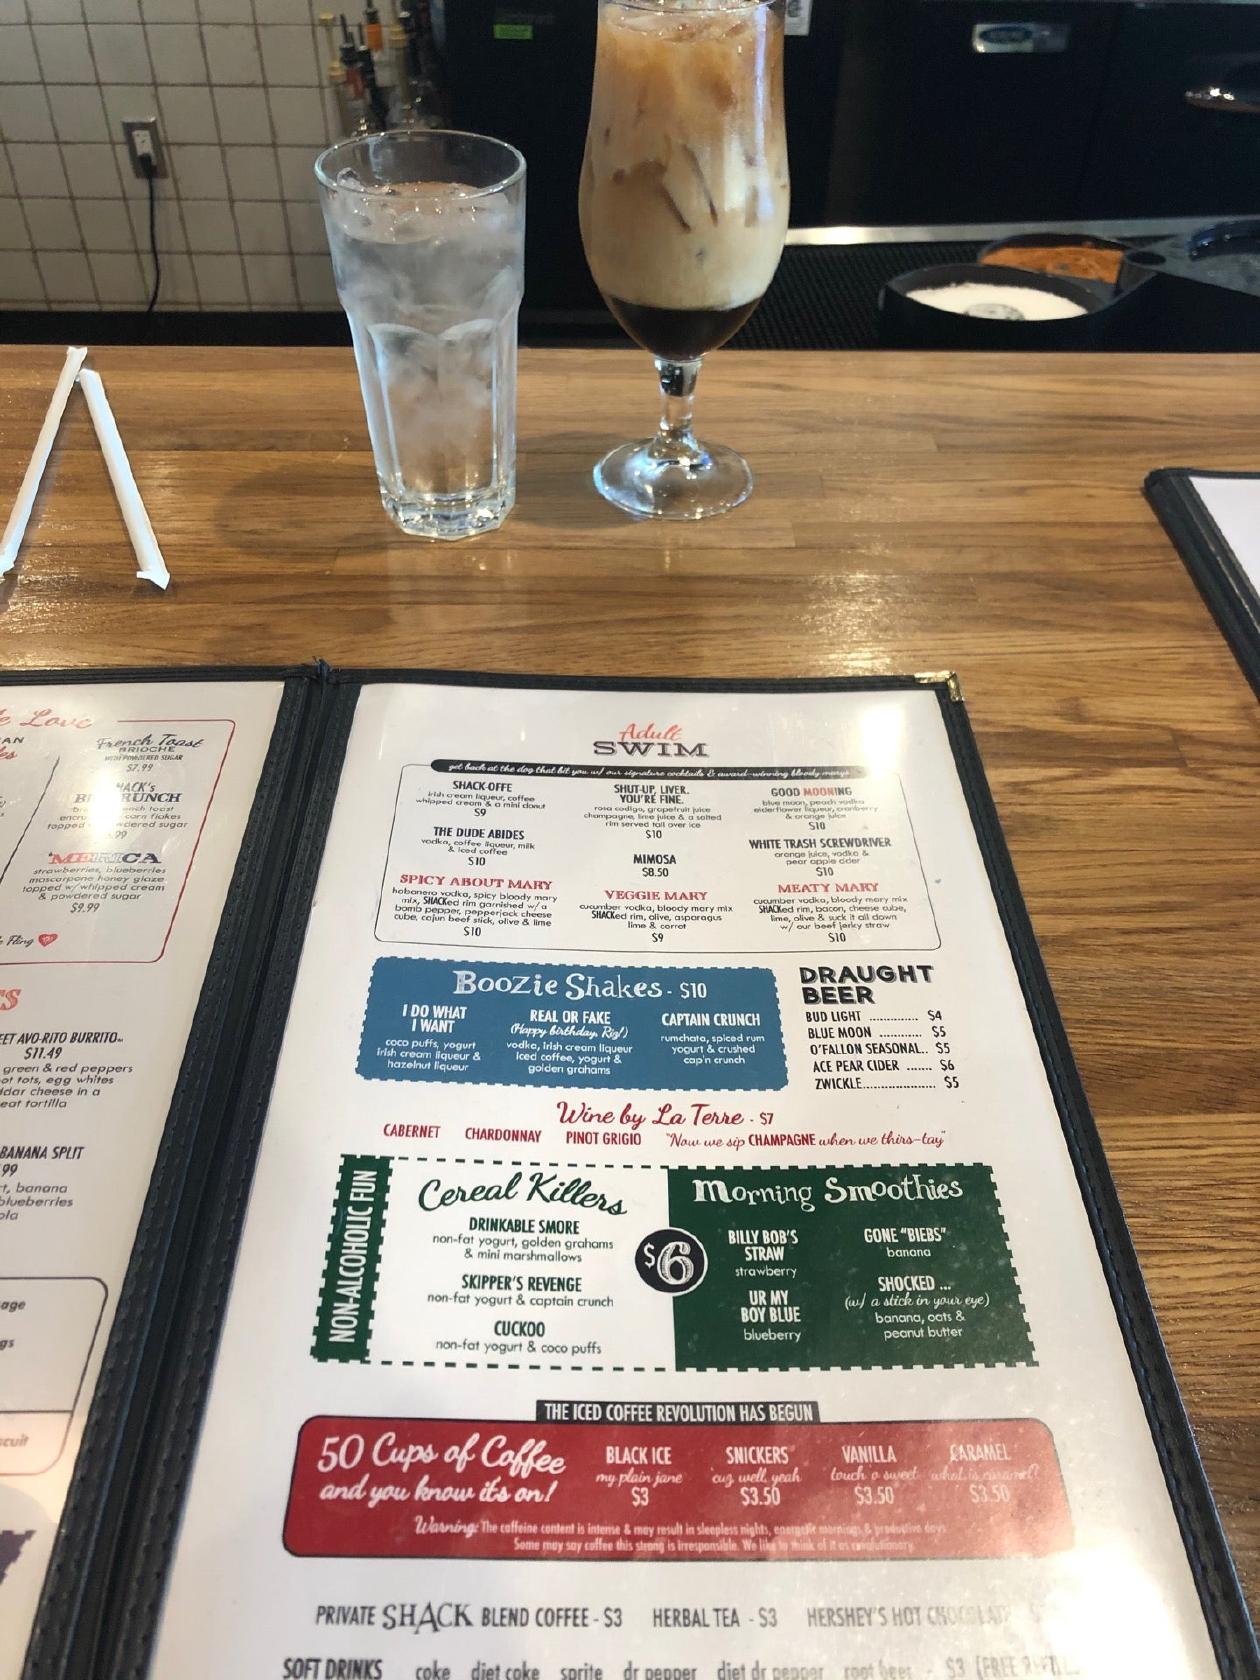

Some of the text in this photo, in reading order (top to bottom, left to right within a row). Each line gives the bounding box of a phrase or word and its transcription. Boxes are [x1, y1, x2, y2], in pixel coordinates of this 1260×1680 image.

[619, 723, 682, 741] Adult
[593, 741, 709, 757] SWIM
[126, 764, 154, 772] $7.99
[452, 780, 513, 792] SHACK-OFFE
[614, 784, 690, 796] SHUT-UP, LIVER.
[771, 787, 852, 796] GOOD MOONING
[620, 795, 684, 804] YOU'RE FINE.
[474, 806, 487, 816] $9
[434, 826, 524, 839] THE DUDE ABIDES
[808, 821, 825, 830] $10
[645, 829, 661, 839] $10
[748, 837, 891, 849] WHITE TRASH SCREWDRIVER
[468, 856, 485, 865] $10
[633, 854, 676, 864] MIMOSA
[642, 867, 668, 877] $8.50
[400, 874, 552, 890] SPICY ABOUT MARY
[778, 882, 878, 893] MEATY MARY
[604, 890, 707, 900] VEGGIE MARY
[70, 902, 100, 913] $9.99
[463, 926, 481, 936] $10
[651, 932, 663, 942] $9
[6, 934, 33, 947] Fling
[800, 965, 934, 984] DRAUGHT
[452, 970, 706, 1000] Boozie Shakes $10
[802, 986, 875, 1004] BEER
[402, 1004, 467, 1019] I DO WHAT
[530, 1009, 610, 1026] REAL OR FAKE
[805, 1011, 860, 1022] BUD LIGHT
[927, 1009, 941, 1021] $4
[412, 1018, 455, 1033] I WANT
[661, 1013, 760, 1026] CAPTAIN CRUNCH
[17, 1032, 67, 1044] AVO-RITO
[808, 1026, 871, 1038] BLUE MOON
[931, 1025, 945, 1037] $5
[24, 1046, 62, 1059] $11.49
[810, 1043, 862, 1055] O'FALLON
[935, 1041, 950, 1054] $5
[683, 1053, 745, 1065] cap'n crunch
[813, 1059, 899, 1072] ACE PEAR CIDER
[939, 1059, 954, 1071] $6
[3, 1063, 132, 1076] green & red peppers
[17, 1075, 114, 1087] tots, egg whites
[25, 1098, 66, 1108] tortilla
[556, 1101, 773, 1130] Wine by La Terre $7
[383, 1123, 440, 1138] CABERNET
[465, 1127, 541, 1142] CHARDONNAY
[566, 1130, 641, 1145] PINOT GRIGIO
[749, 1133, 816, 1146] CHAMPAGNE
[51, 1146, 84, 1160] SPLIT
[15, 1182, 67, 1193] banana
[418, 1172, 628, 1215] Cereal Killers
[692, 1174, 962, 1211] Morning Smoothies
[469, 1217, 579, 1234] DRINKABLE SMORE
[728, 1229, 798, 1244] BILLY BOB'S
[864, 1227, 945, 1242] GONE "BIEBS"
[432, 1233, 613, 1251] non-fat yogurt, golden grahams
[329, 1170, 377, 1343] NON-ALCOHOLIC FUN
[744, 1245, 784, 1263] STRAW
[886, 1246, 930, 1257] banana
[643, 1241, 694, 1285] $6
[735, 1264, 796, 1278] strawberry
[461, 1274, 581, 1292] SKIPPER'S REVENGE
[878, 1275, 934, 1293] SHOCKED
[749, 1289, 787, 1307] UR MY
[740, 1306, 800, 1324] BOY BLUE
[494, 1320, 545, 1337] CUCKOO
[743, 1328, 801, 1342] blueberry
[884, 1326, 962, 1341] peanut butter
[544, 1403, 812, 1421] THE ICED COFFEE REVOLUTION HAS BEGUN
[317, 1431, 567, 1478] 50 Cups of Coffee
[606, 1446, 671, 1464] BLACK ICE
[725, 1446, 788, 1464] SNICKERS
[841, 1445, 897, 1463] VANILLA
[319, 1473, 558, 1508] and you know on!
[631, 1486, 648, 1506] $3
[740, 1485, 780, 1506] $3.50
[852, 1484, 896, 1506] $3.50
[315, 1601, 621, 1635] PRIVATE SHACK BLEND COFFEE $3
[653, 1607, 777, 1627] HERBAL TEA $3
